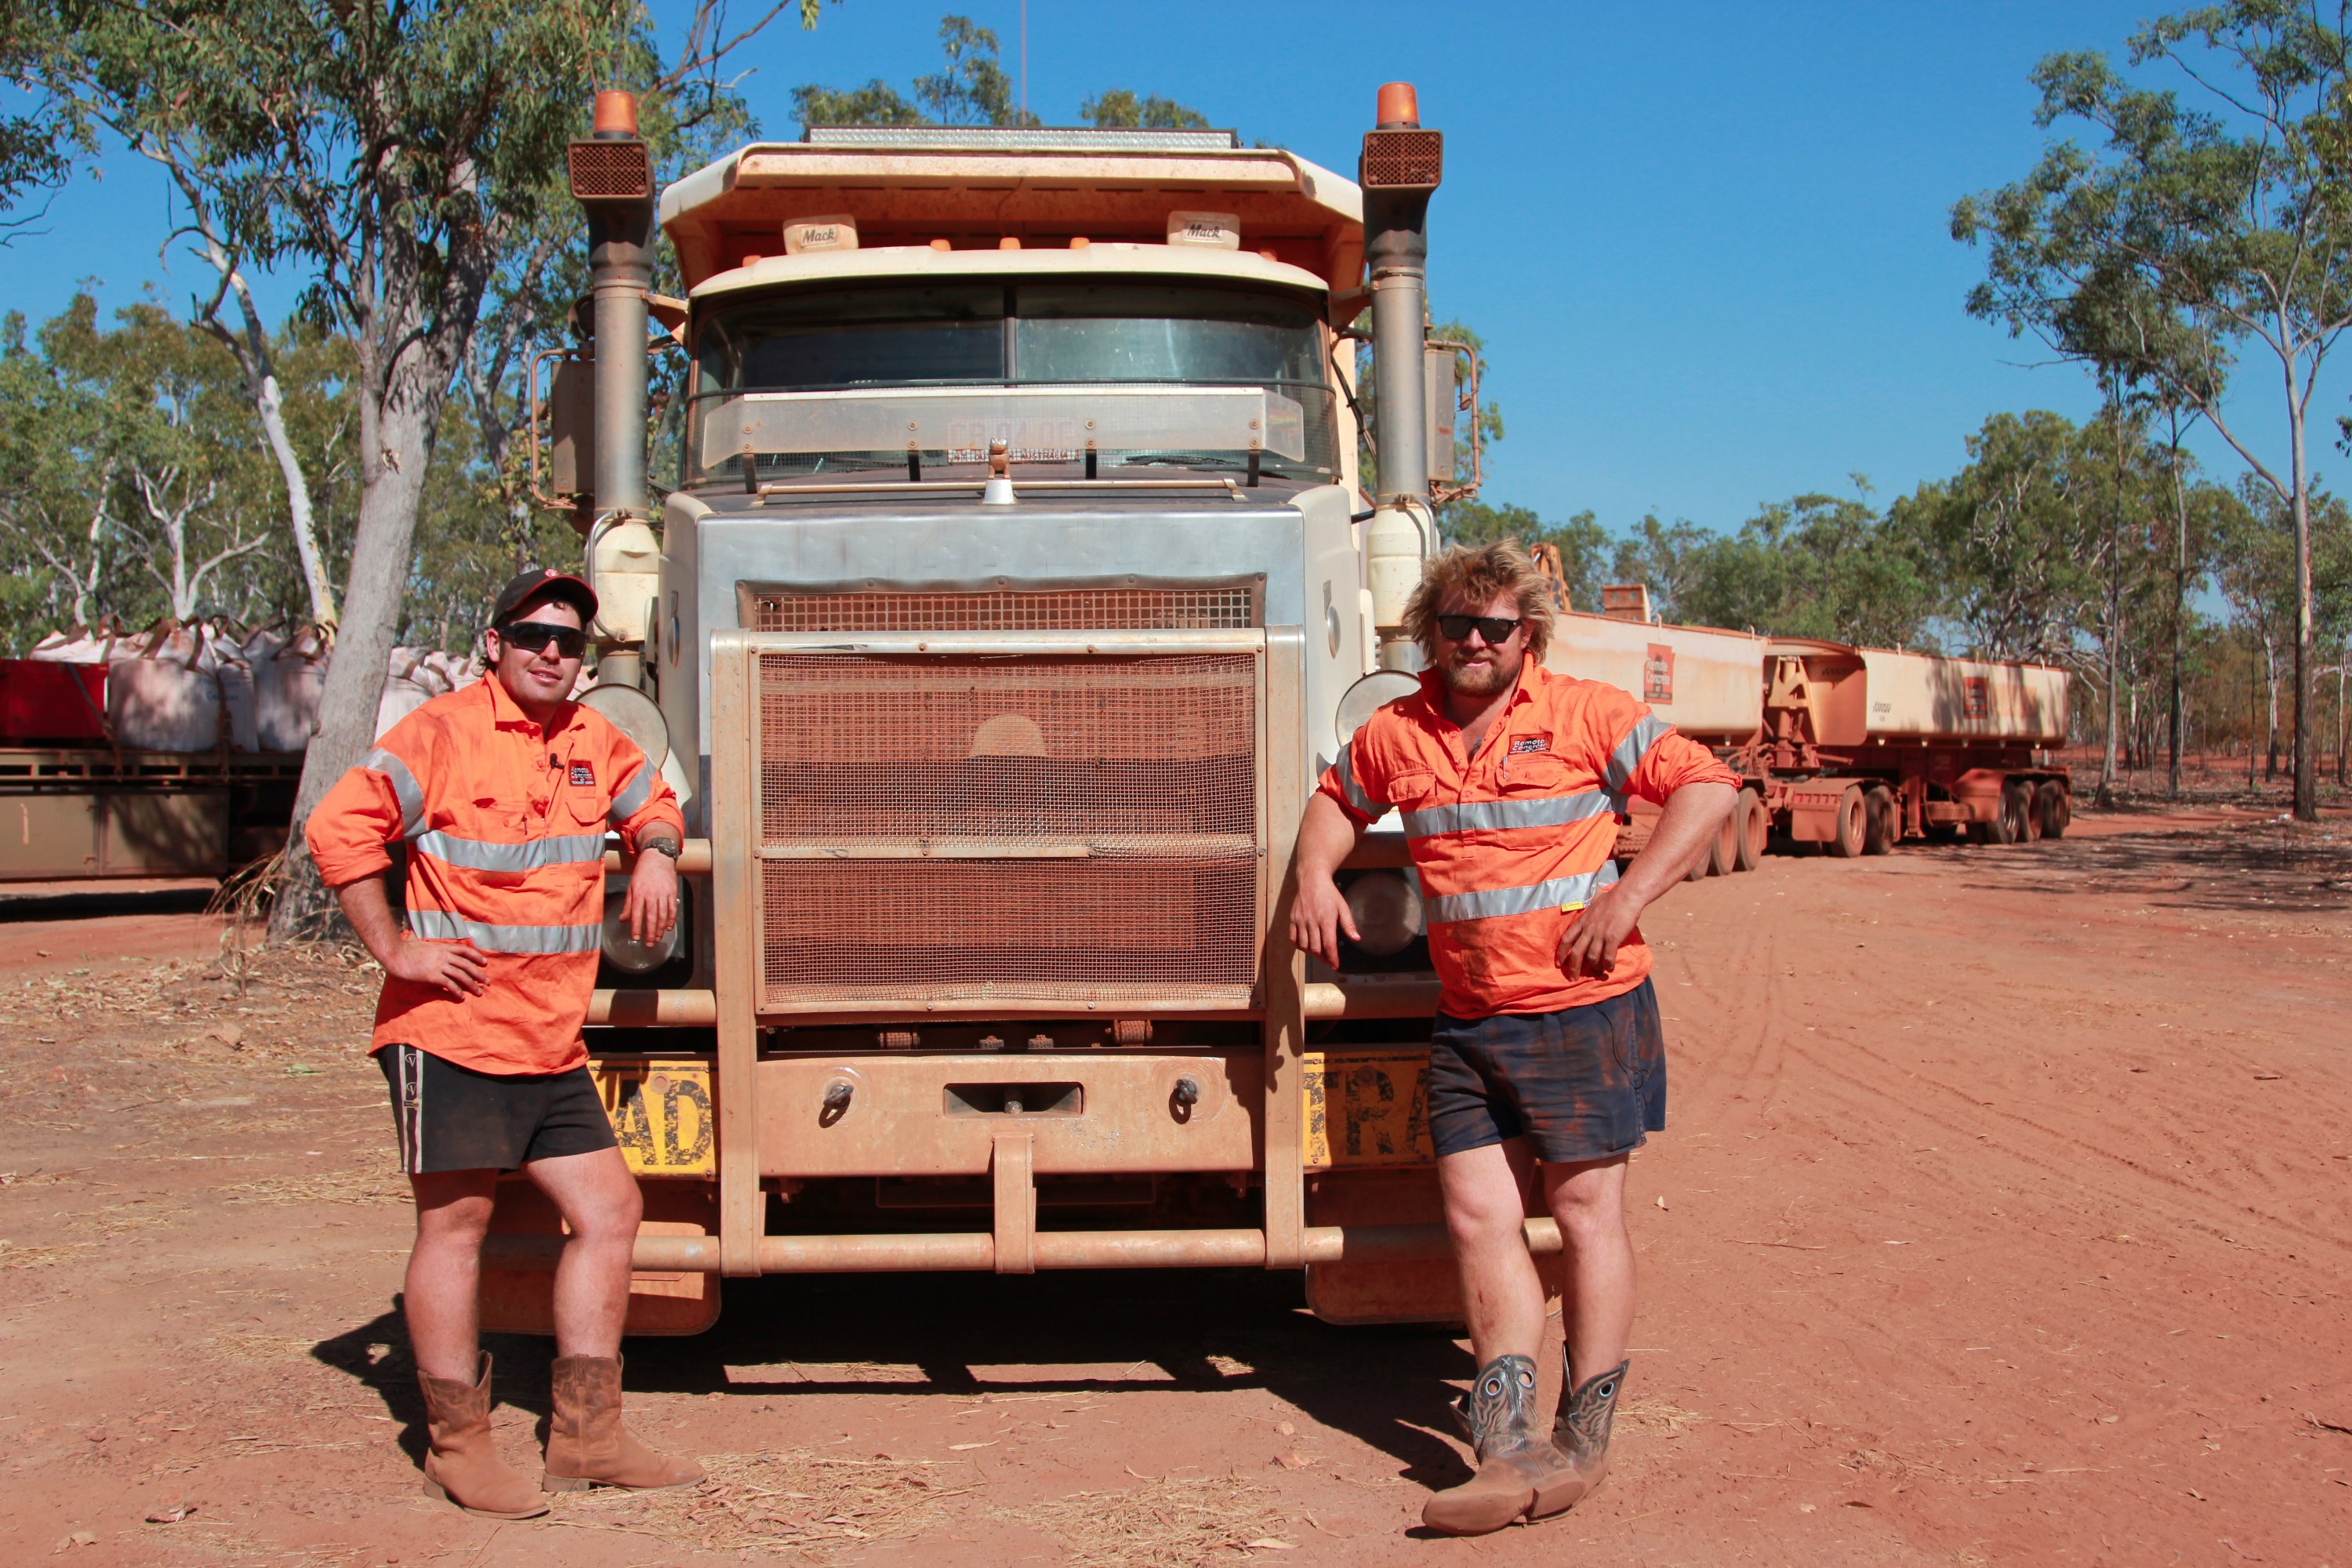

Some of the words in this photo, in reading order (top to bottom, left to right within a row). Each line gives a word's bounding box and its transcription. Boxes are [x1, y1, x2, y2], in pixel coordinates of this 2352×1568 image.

[802, 227, 835, 243] Mack
[1187, 223, 1220, 238] Mack
[1021, 451, 1068, 459] AUSTRALIA
[1304, 1068, 1432, 1158] TRA
[614, 1079, 712, 1166] AD
